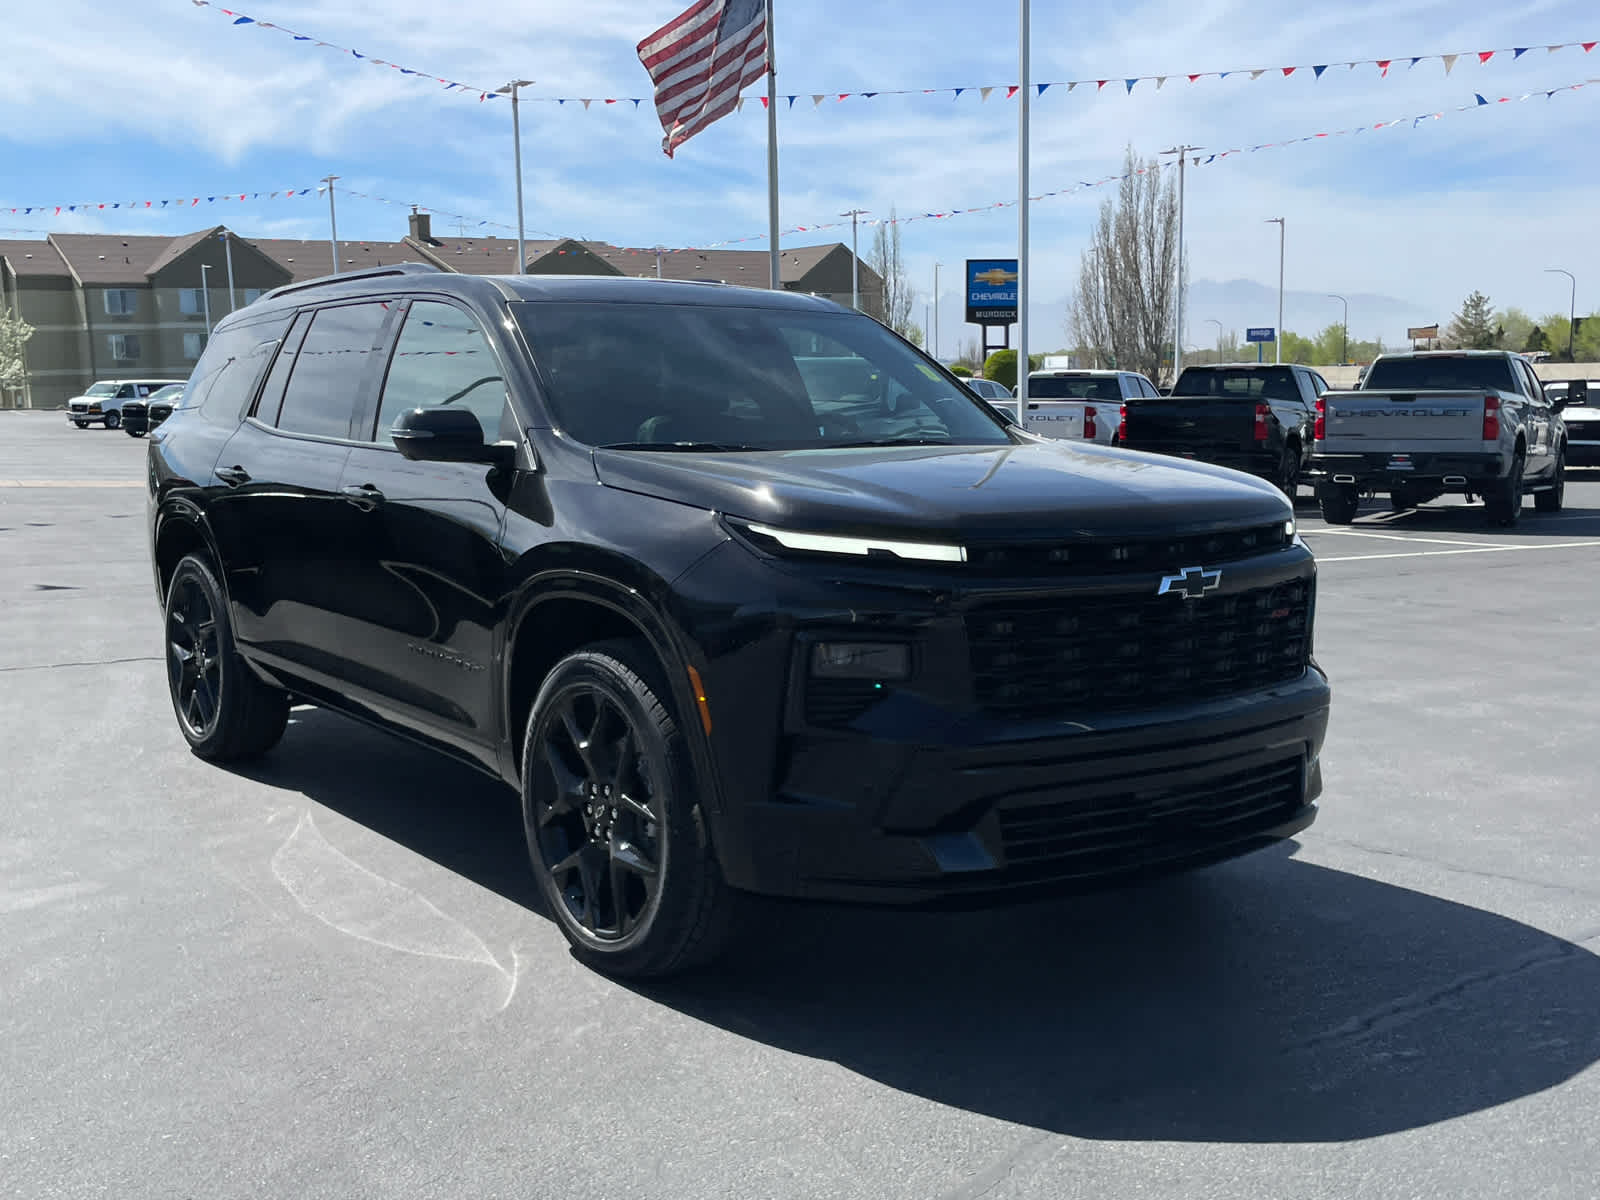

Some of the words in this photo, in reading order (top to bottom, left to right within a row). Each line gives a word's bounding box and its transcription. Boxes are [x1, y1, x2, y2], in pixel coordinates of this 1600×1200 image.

[971, 292, 1017, 301] CHEVROLE
[975, 310, 1017, 318] MURDOCK
[1335, 408, 1473, 418] CHEVROLET
